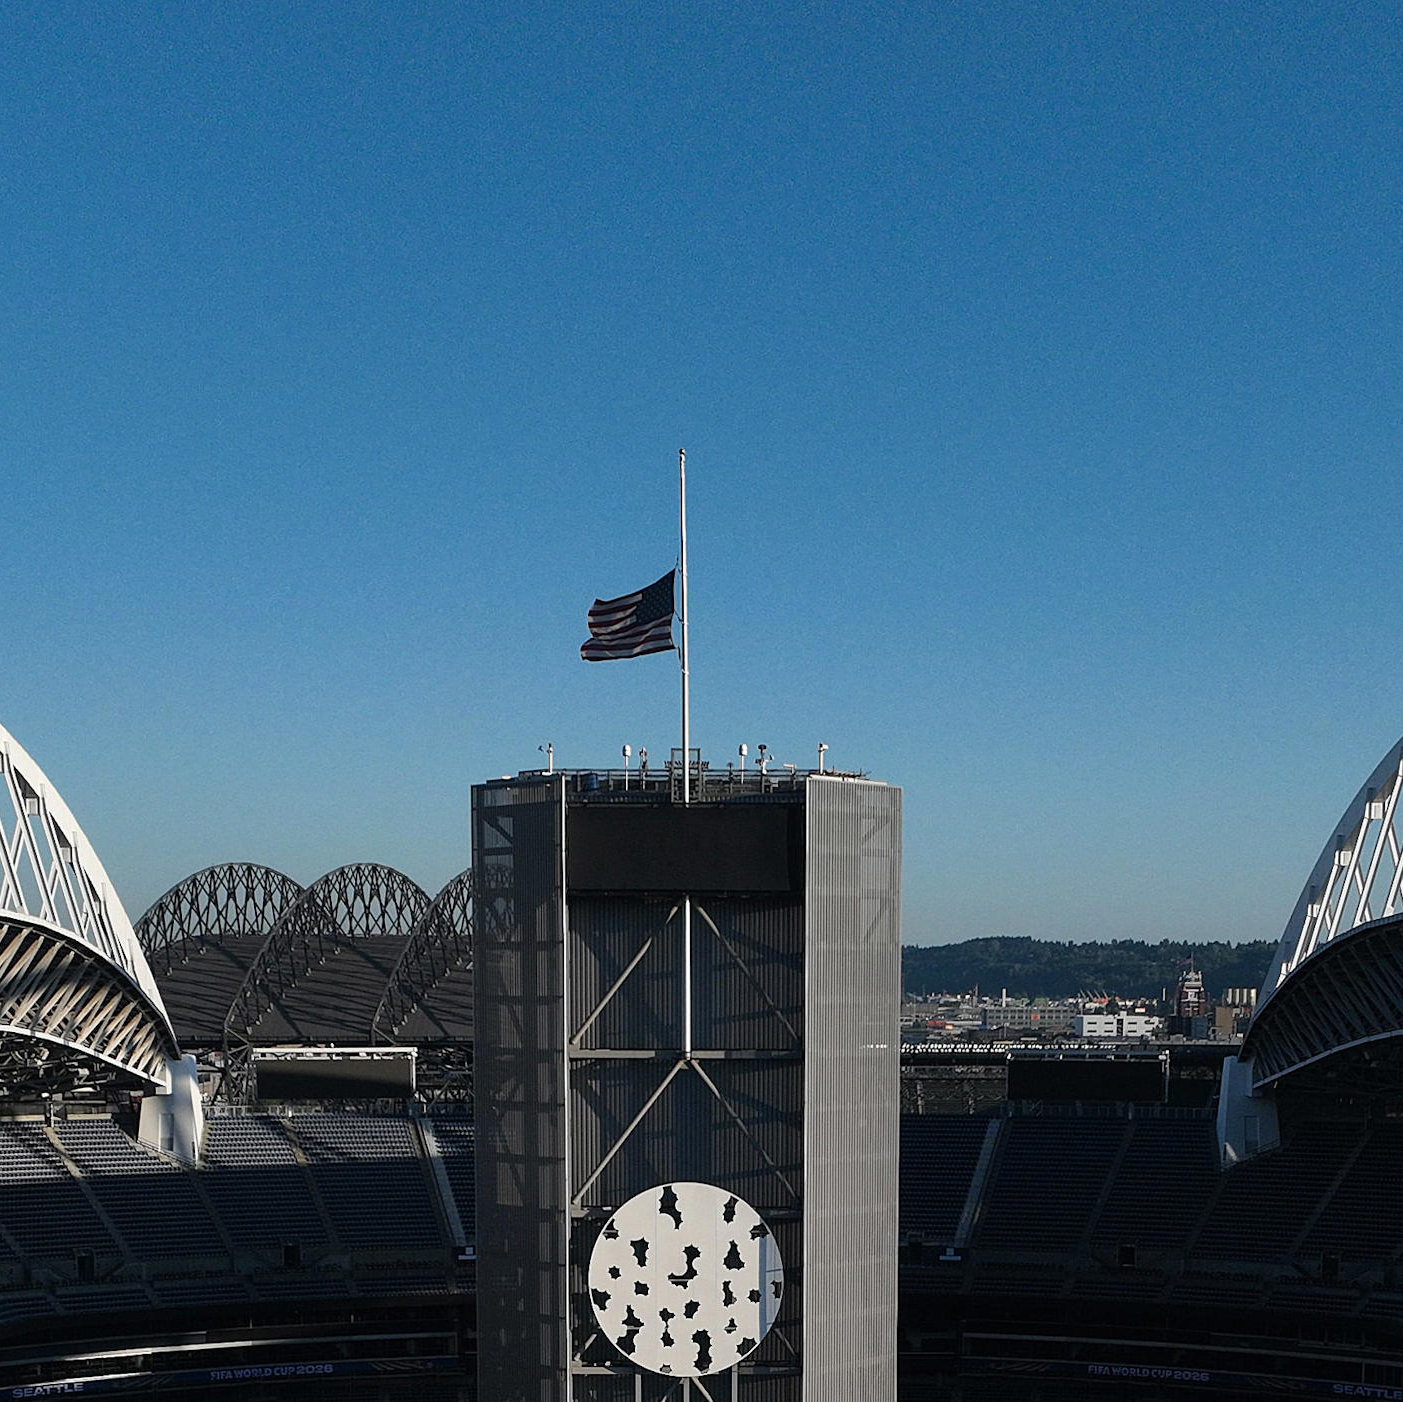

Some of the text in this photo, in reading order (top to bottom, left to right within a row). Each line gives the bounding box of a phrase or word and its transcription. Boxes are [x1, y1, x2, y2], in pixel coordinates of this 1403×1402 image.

[209, 1363, 334, 1381] FIFA WORLD CUP 2026
[1087, 1364, 1211, 1382] FIFA WORLD CUP 2026
[12, 1382, 85, 1399] SEATTLE
[1333, 1383, 1403, 1400] SEATTLE
